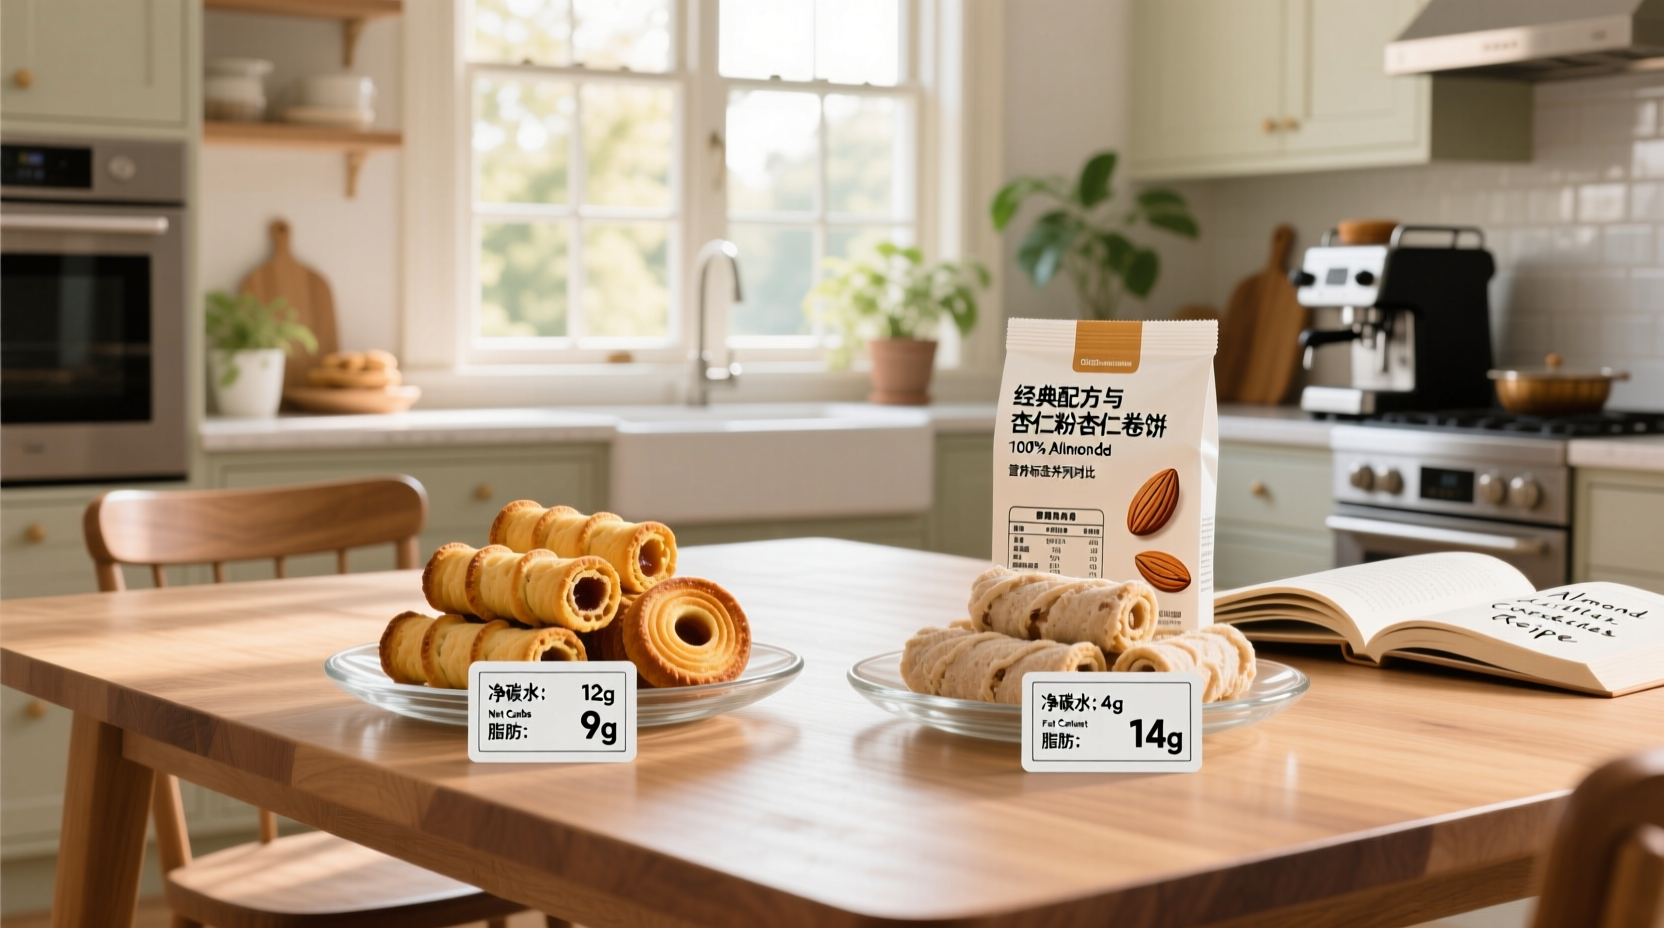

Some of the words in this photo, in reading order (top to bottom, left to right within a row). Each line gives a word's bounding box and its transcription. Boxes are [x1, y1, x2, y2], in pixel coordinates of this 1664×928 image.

[1013, 384, 1124, 409] 经典配方与
[1011, 410, 1168, 438] 杏仁粉杏仁卷饼
[1008, 440, 1046, 455] 100%
[1547, 591, 1649, 620] Almond
[581, 683, 615, 706] 12g
[1100, 695, 1124, 714] 4g
[488, 722, 528, 741] 脂肪：
[580, 710, 617, 745] 9g
[1041, 732, 1081, 750] 脂肪：
[1129, 718, 1183, 755] 14g
